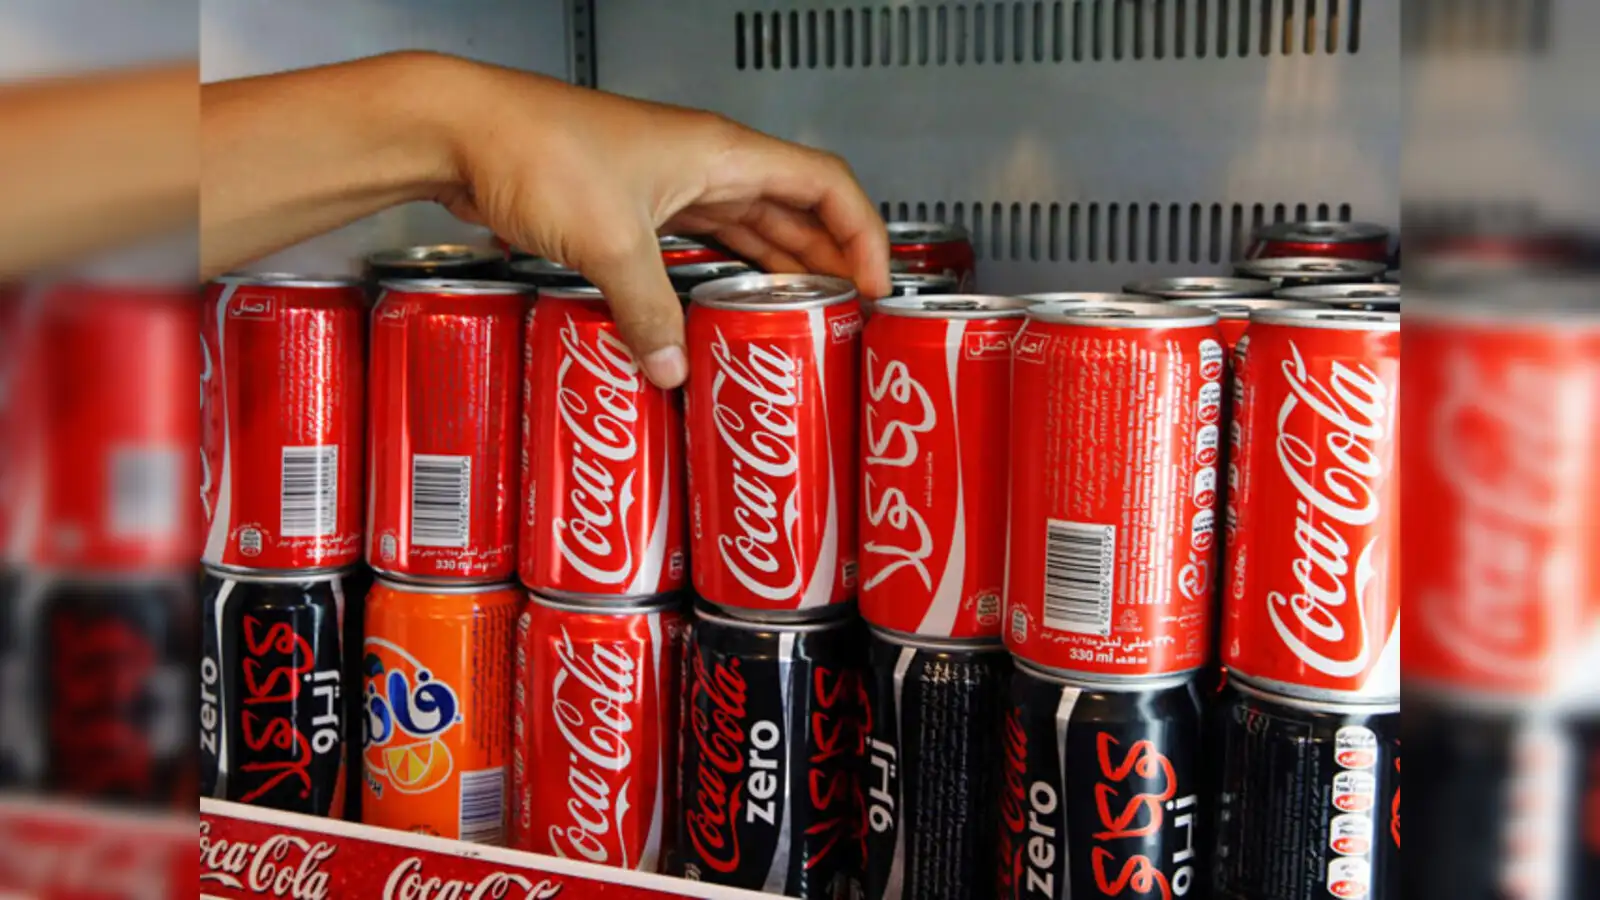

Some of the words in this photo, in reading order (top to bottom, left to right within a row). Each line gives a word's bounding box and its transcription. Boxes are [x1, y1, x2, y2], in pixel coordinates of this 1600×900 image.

[553, 312, 640, 584] Coca-Cola
[711, 324, 801, 601] Coca-Cola
[1267, 339, 1388, 677] Coca-Cola
[436, 559, 456, 570] 330
[1069, 648, 1093, 662] 330
[1096, 648, 1114, 663] ml
[687, 642, 748, 873] Coca-Cola
[747, 720, 780, 825] zero
[1027, 780, 1058, 900] zero
